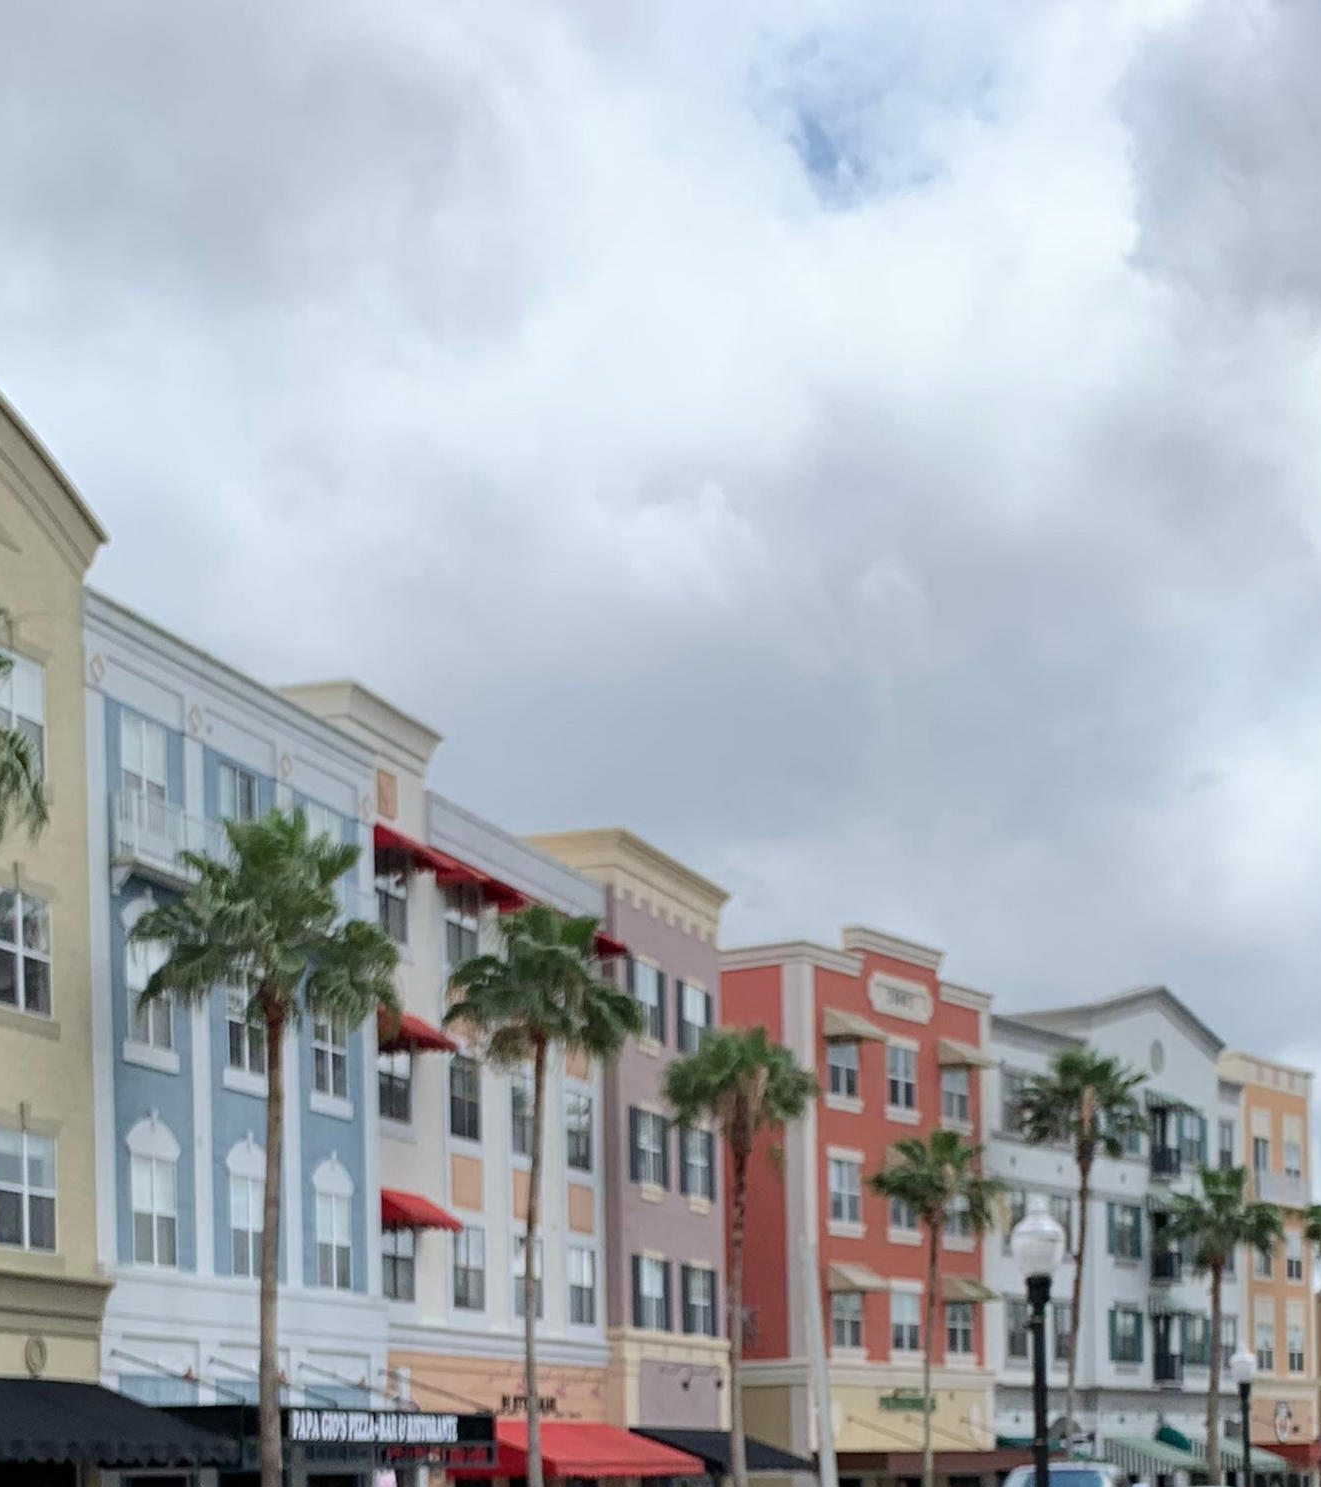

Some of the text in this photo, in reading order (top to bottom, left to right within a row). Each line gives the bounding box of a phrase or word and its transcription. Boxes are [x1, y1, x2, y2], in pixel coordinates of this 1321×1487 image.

[291, 1410, 320, 1441] PAPA
[320, 1411, 347, 1442] GIO'S
[348, 1412, 375, 1442] PIZZA
